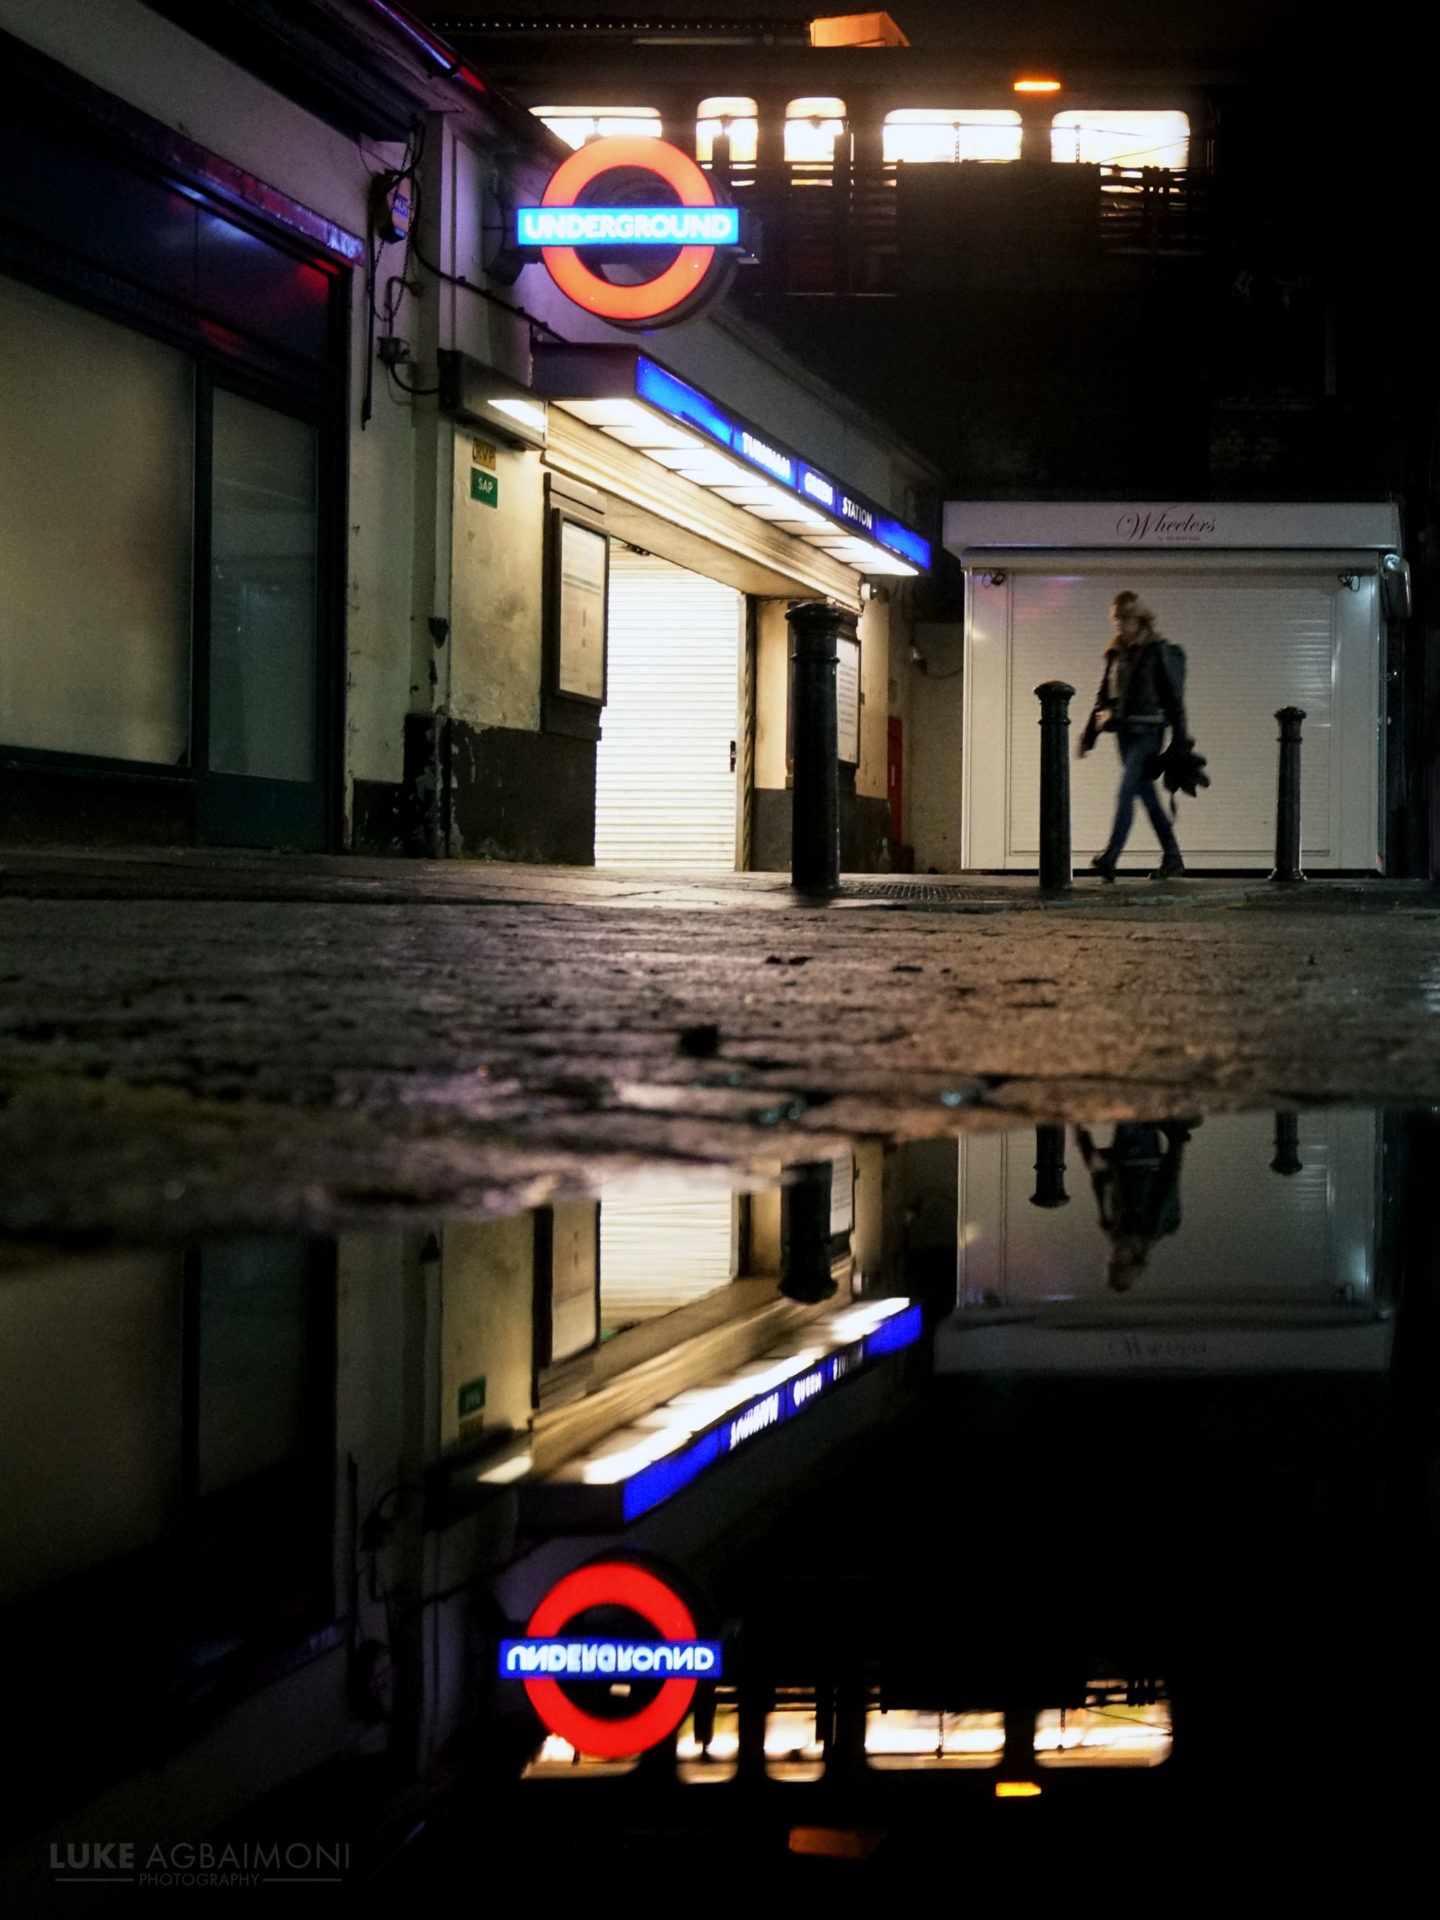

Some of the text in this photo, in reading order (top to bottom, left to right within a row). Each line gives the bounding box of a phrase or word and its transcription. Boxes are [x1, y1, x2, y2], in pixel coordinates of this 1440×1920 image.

[525, 214, 732, 239] UNDERGROUND
[841, 497, 873, 530] STATION
[1116, 505, 1216, 541] Wheelers
